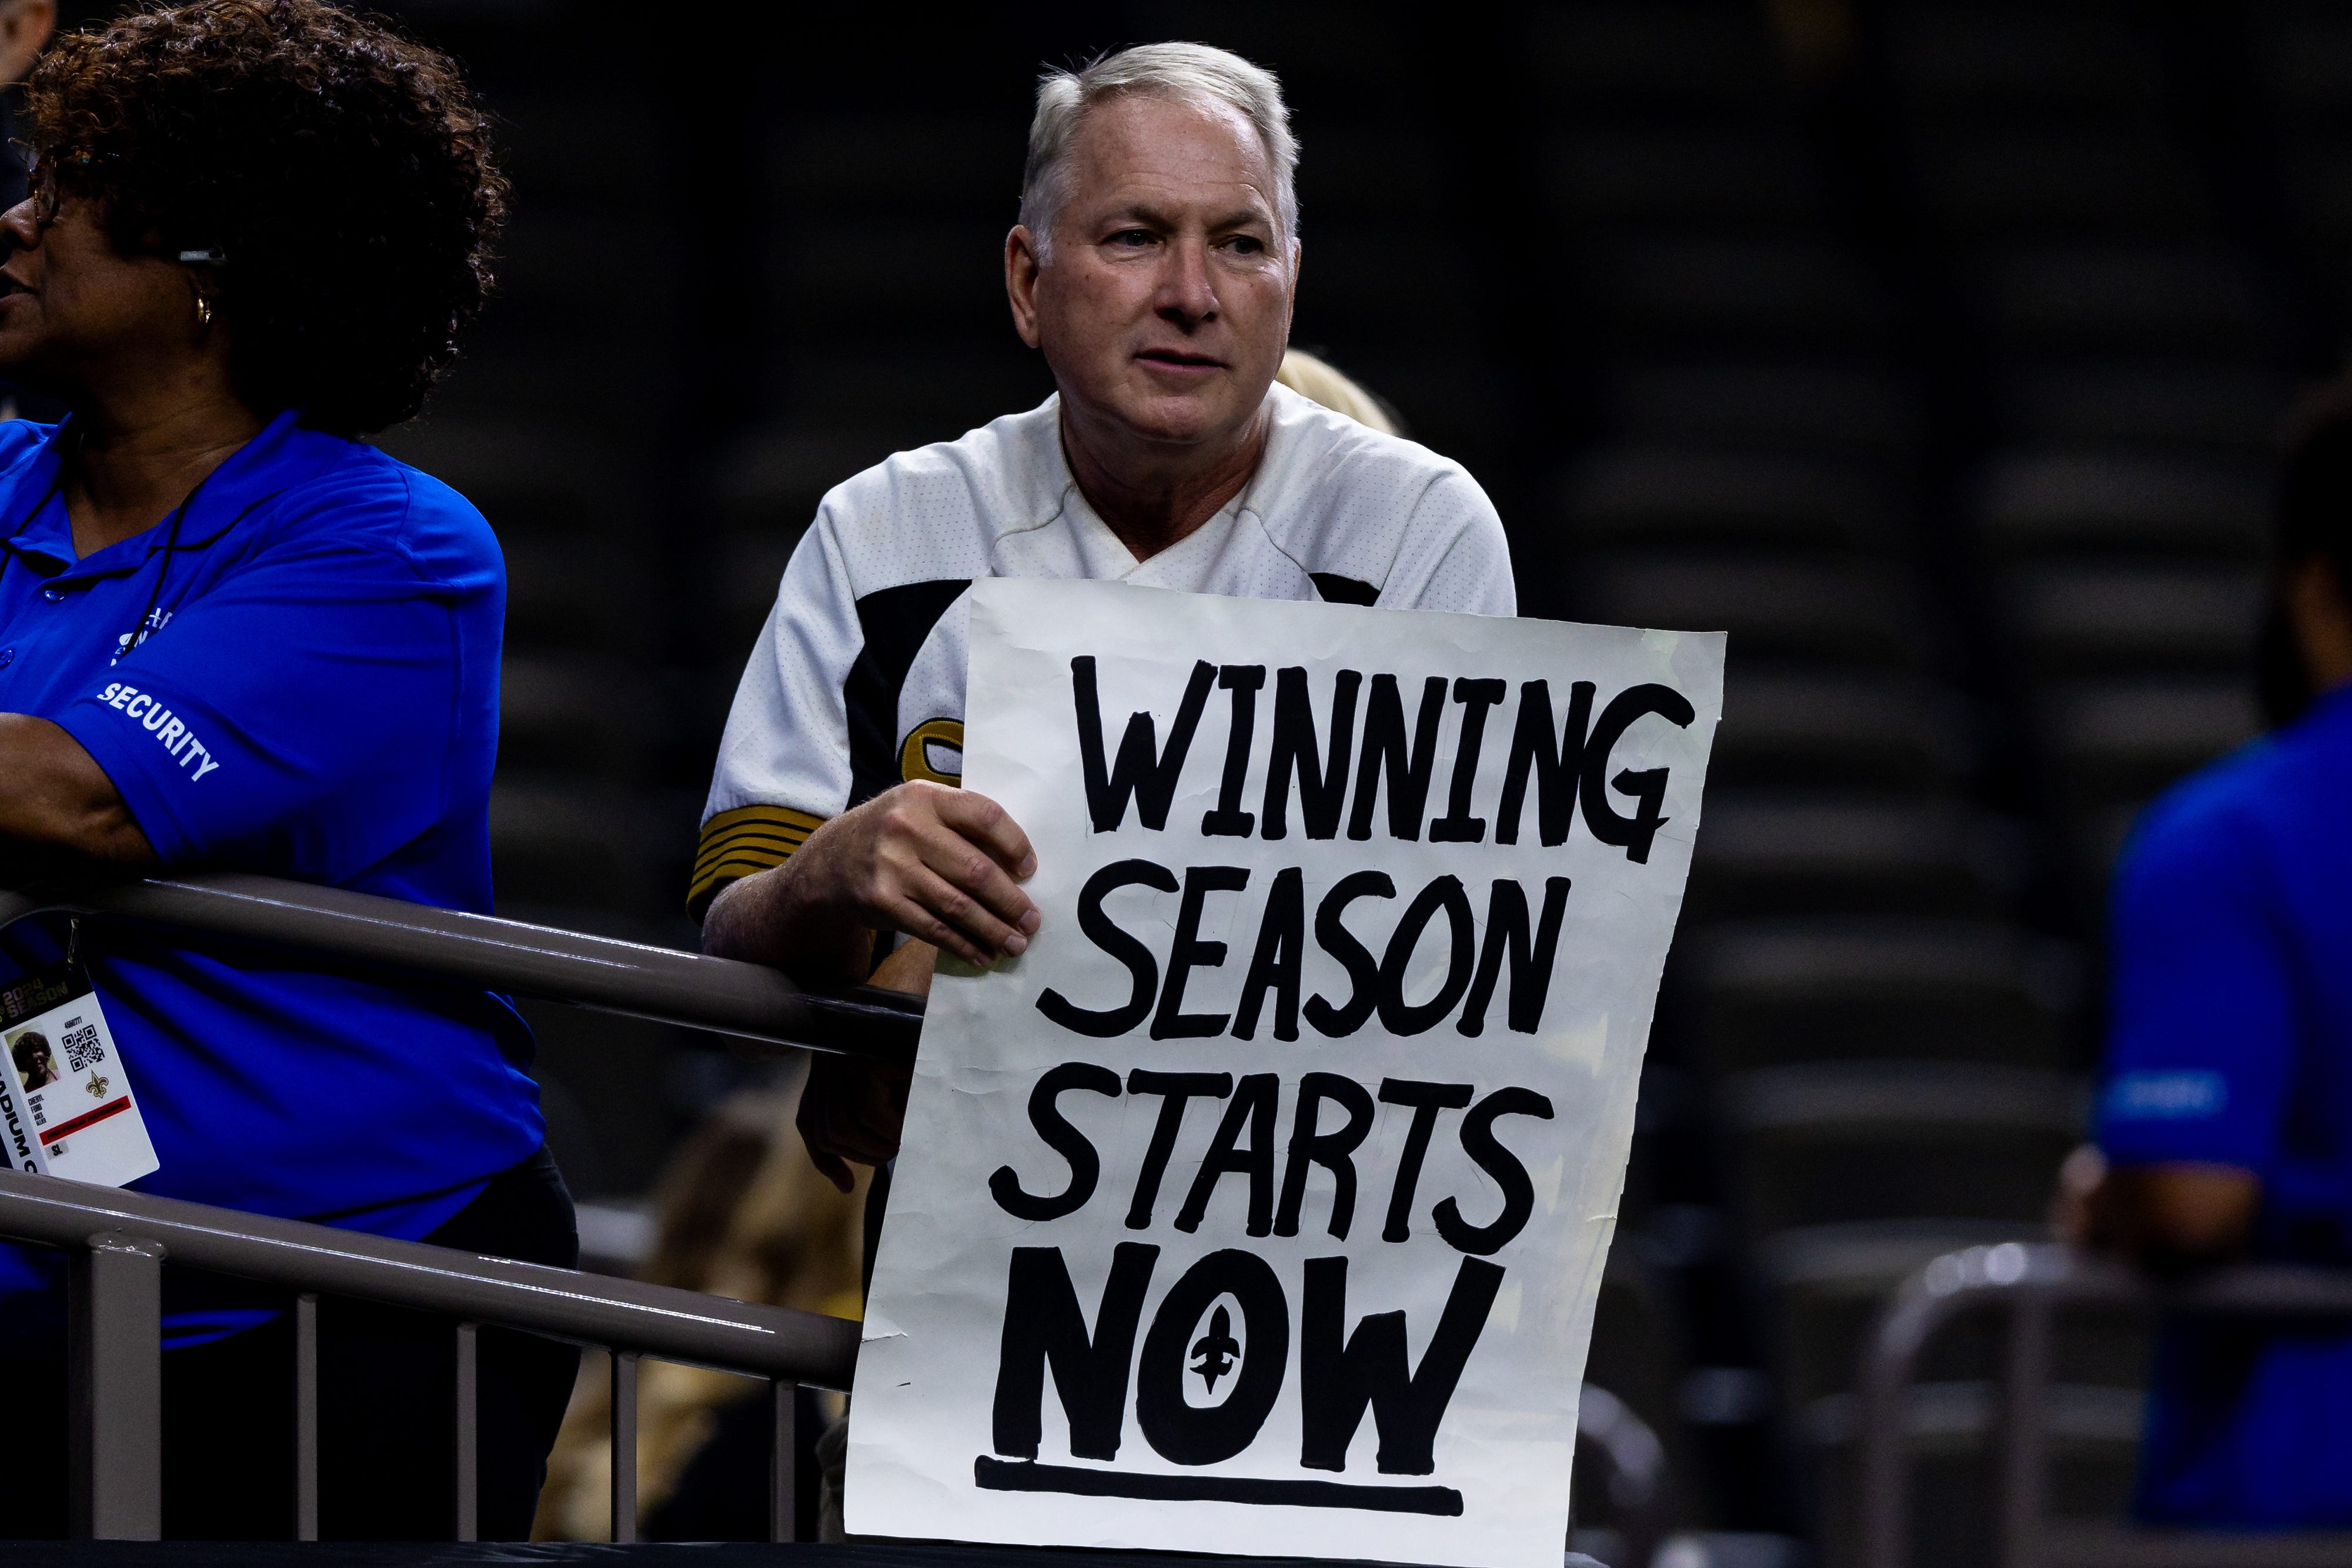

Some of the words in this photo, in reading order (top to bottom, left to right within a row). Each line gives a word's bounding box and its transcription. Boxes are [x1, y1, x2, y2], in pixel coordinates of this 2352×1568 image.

[96, 683, 220, 783] SECURITY
[1071, 656, 1695, 864] WINNING
[2, 978, 44, 1007] 2024
[6, 980, 69, 1019] SEASON
[1035, 859, 1571, 1042] SEASON
[0, 1070, 31, 1158] ADIUM
[46, 1128, 60, 1139] NO
[988, 1062, 1554, 1256] STARTS
[993, 1241, 1506, 1476] NOW
